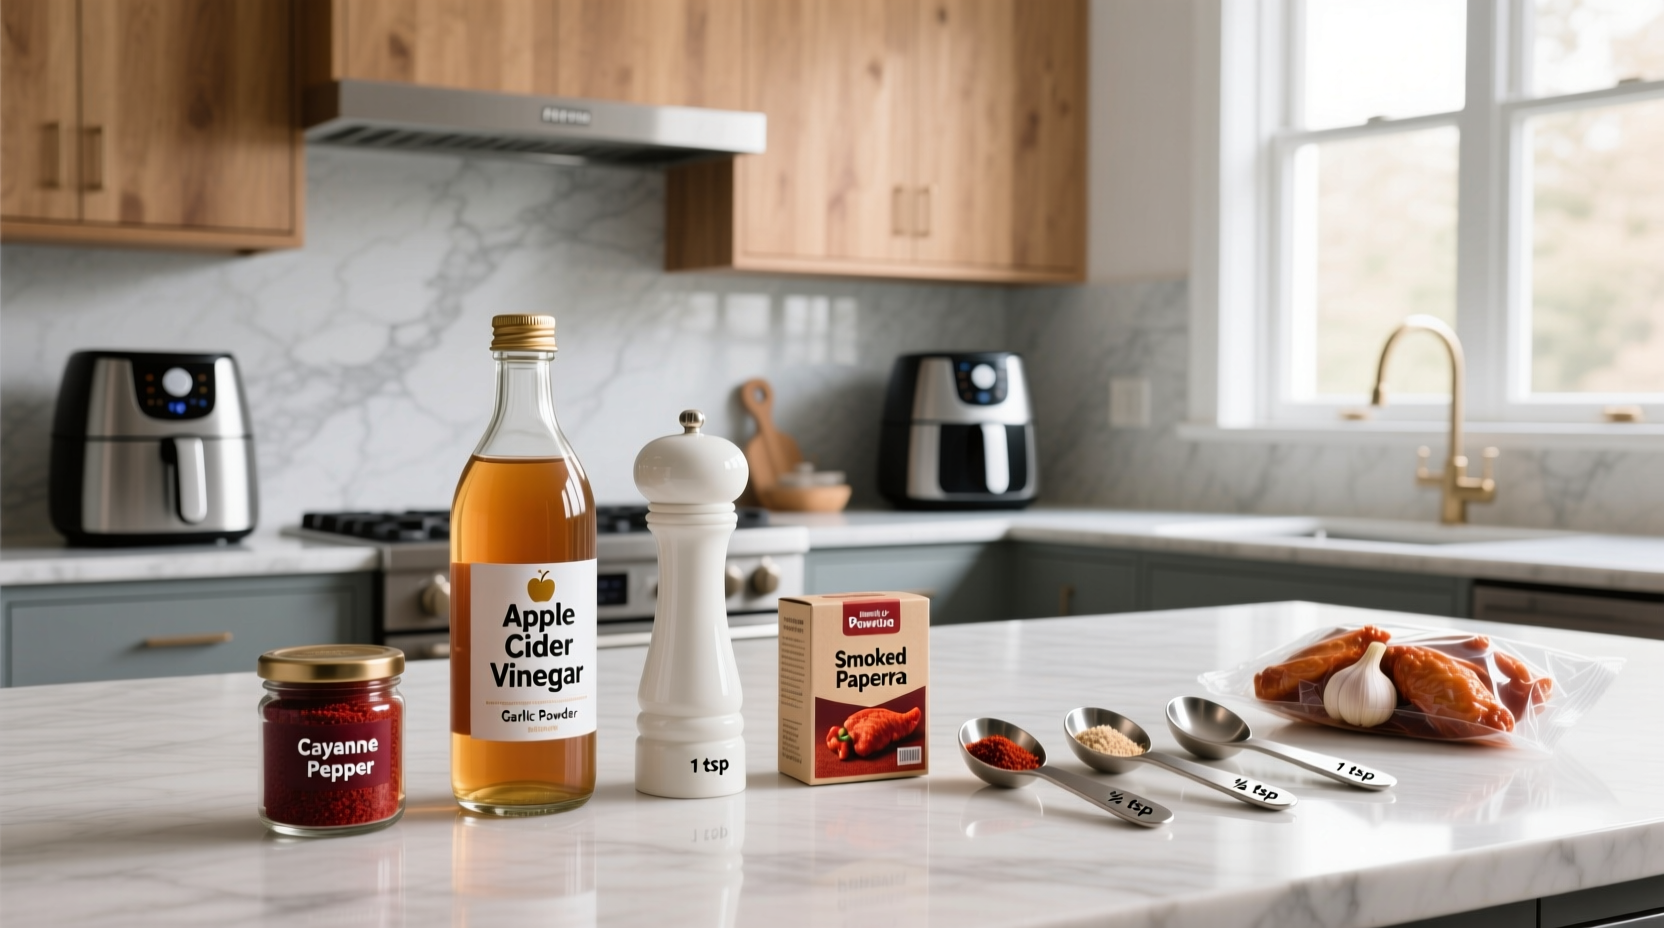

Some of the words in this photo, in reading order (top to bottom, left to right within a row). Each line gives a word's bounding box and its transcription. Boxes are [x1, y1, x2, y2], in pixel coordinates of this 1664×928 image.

[502, 602, 575, 632] Apple
[505, 633, 574, 659] Cider
[835, 646, 907, 669] Smoked
[490, 662, 584, 693] Vinegar
[836, 670, 907, 693] Paperra
[538, 707, 578, 721] Powder
[297, 738, 379, 760] Cayanne
[307, 760, 375, 782] Pepper
[690, 758, 698, 773] 1
[702, 757, 729, 776] tsp
[1336, 762, 1345, 771] 1
[1348, 766, 1375, 781] tsp
